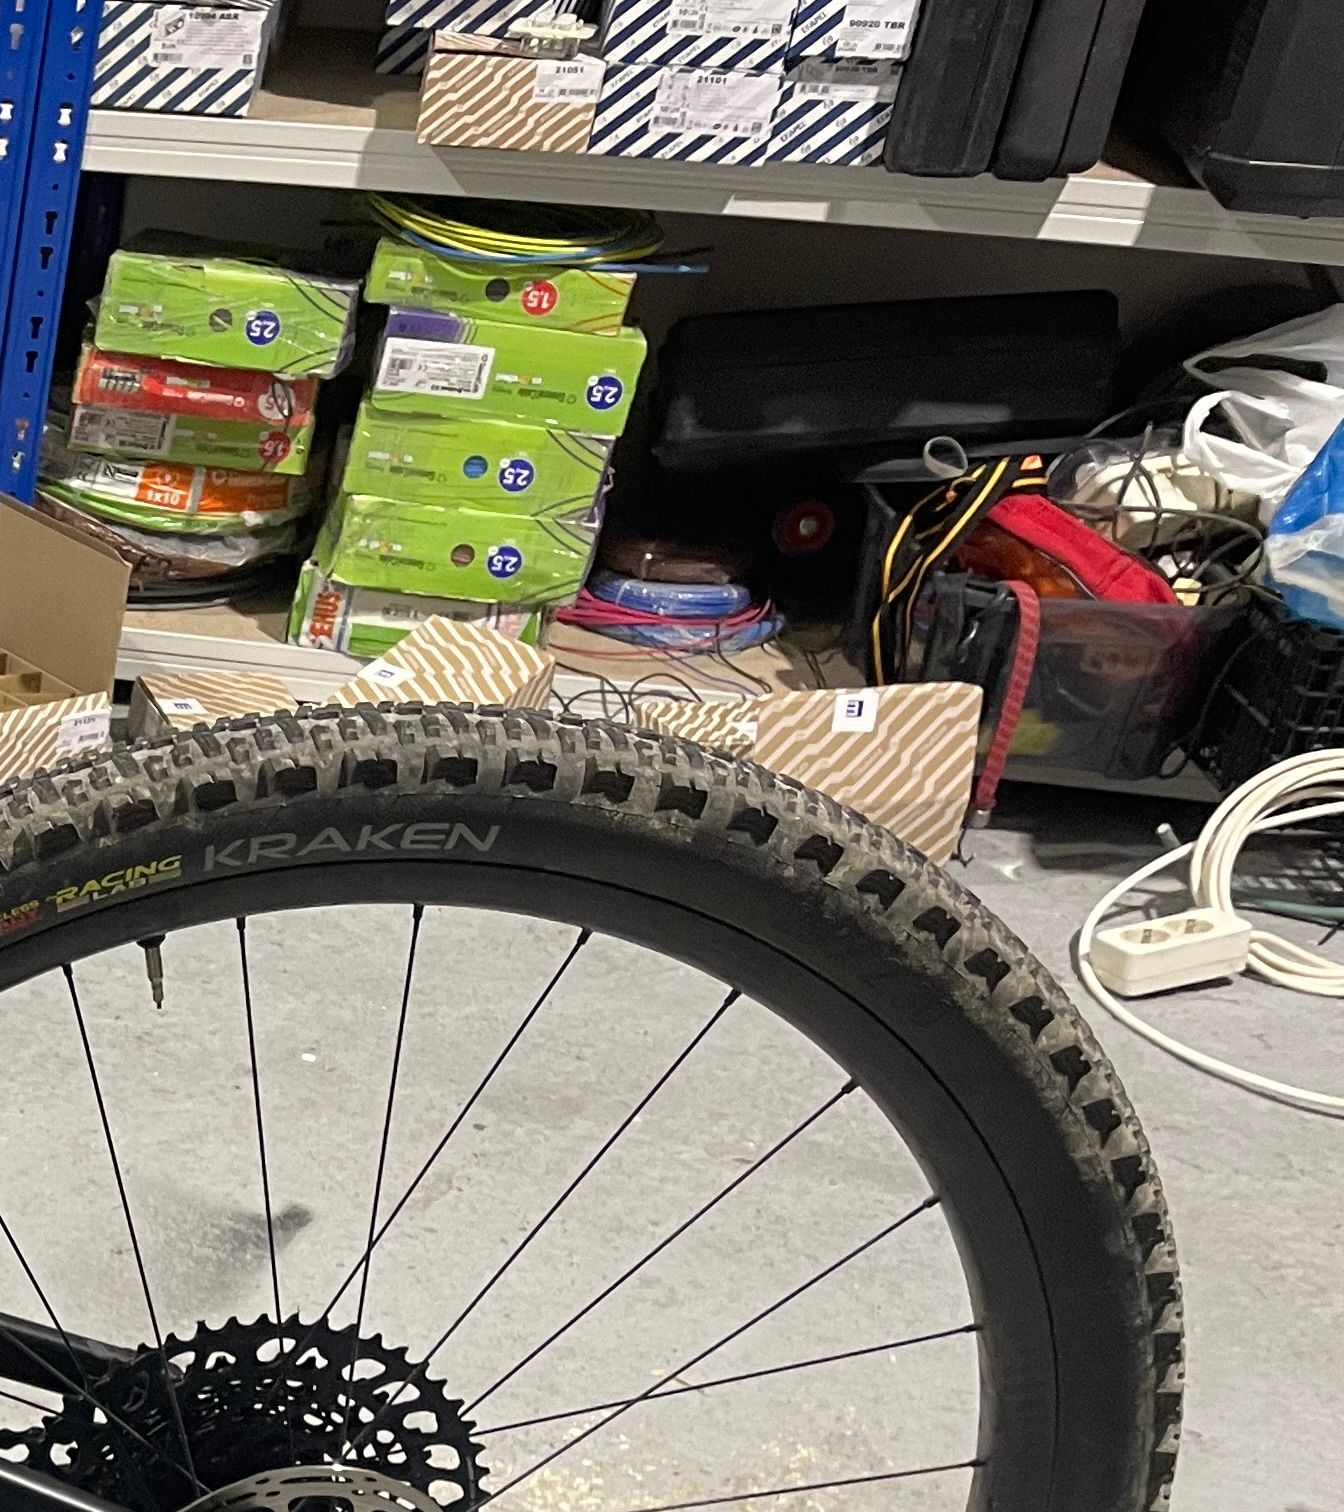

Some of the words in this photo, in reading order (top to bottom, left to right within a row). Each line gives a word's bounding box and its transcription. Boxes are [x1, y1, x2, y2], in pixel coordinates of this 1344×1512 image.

[849, 19, 880, 29] 90920
[884, 20, 906, 30] TBR
[697, 76, 728, 85] 21101
[202, 822, 501, 874] KRAKEN
[54, 854, 183, 904] RACING
